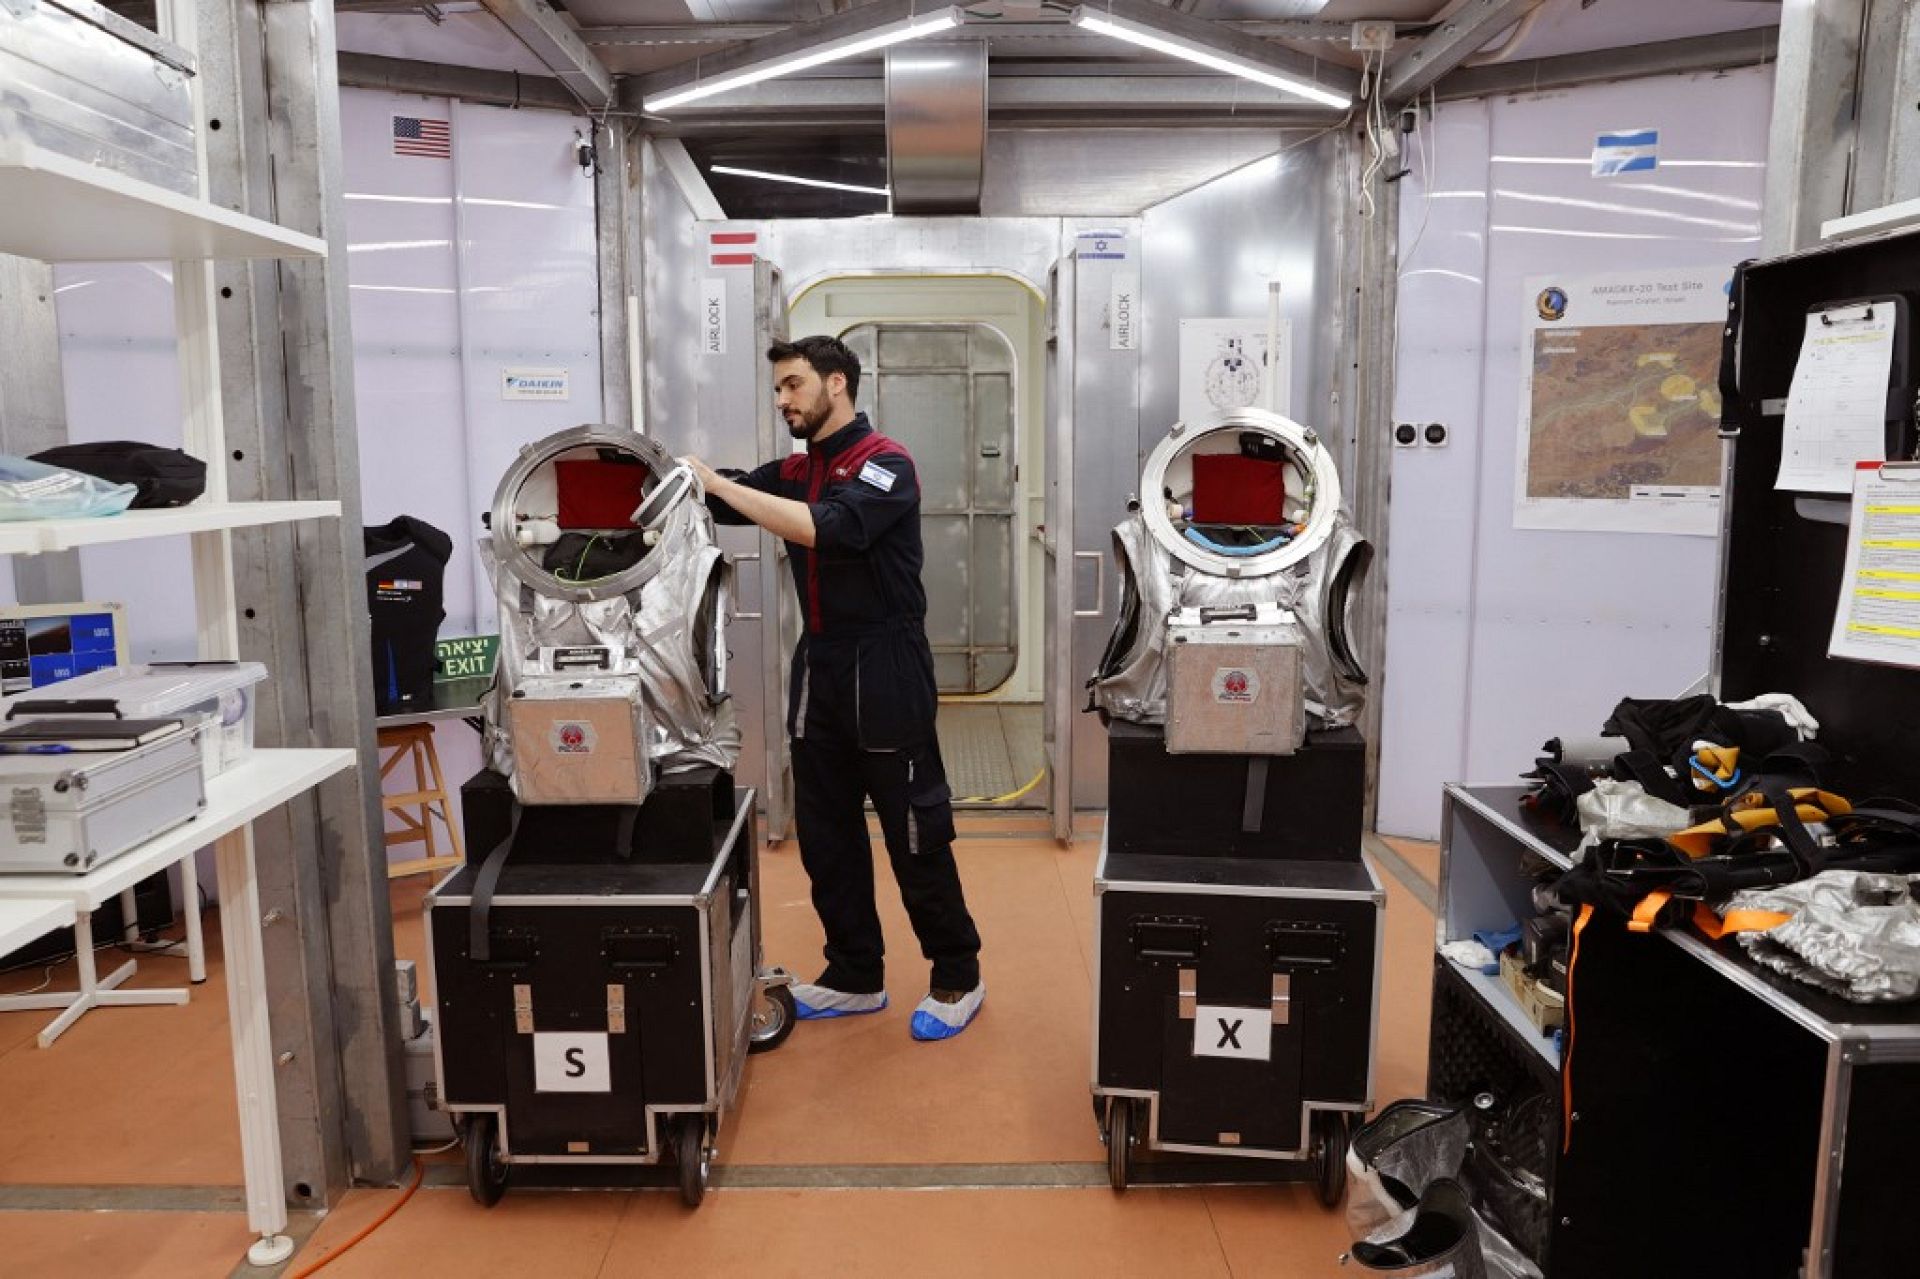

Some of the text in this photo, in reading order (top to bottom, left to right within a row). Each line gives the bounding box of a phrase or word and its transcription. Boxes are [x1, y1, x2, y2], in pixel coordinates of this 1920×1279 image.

[1656, 282, 1678, 291] Test
[1682, 280, 1703, 290] Site
[708, 297, 721, 351] AIRLOCK
[1118, 294, 1130, 347] AIRLOCK
[518, 380, 564, 389] DAIKIN
[438, 639, 488, 657] יציאה
[445, 655, 486, 675] EXIT
[1217, 1018, 1243, 1049] X
[565, 1047, 586, 1077] S
